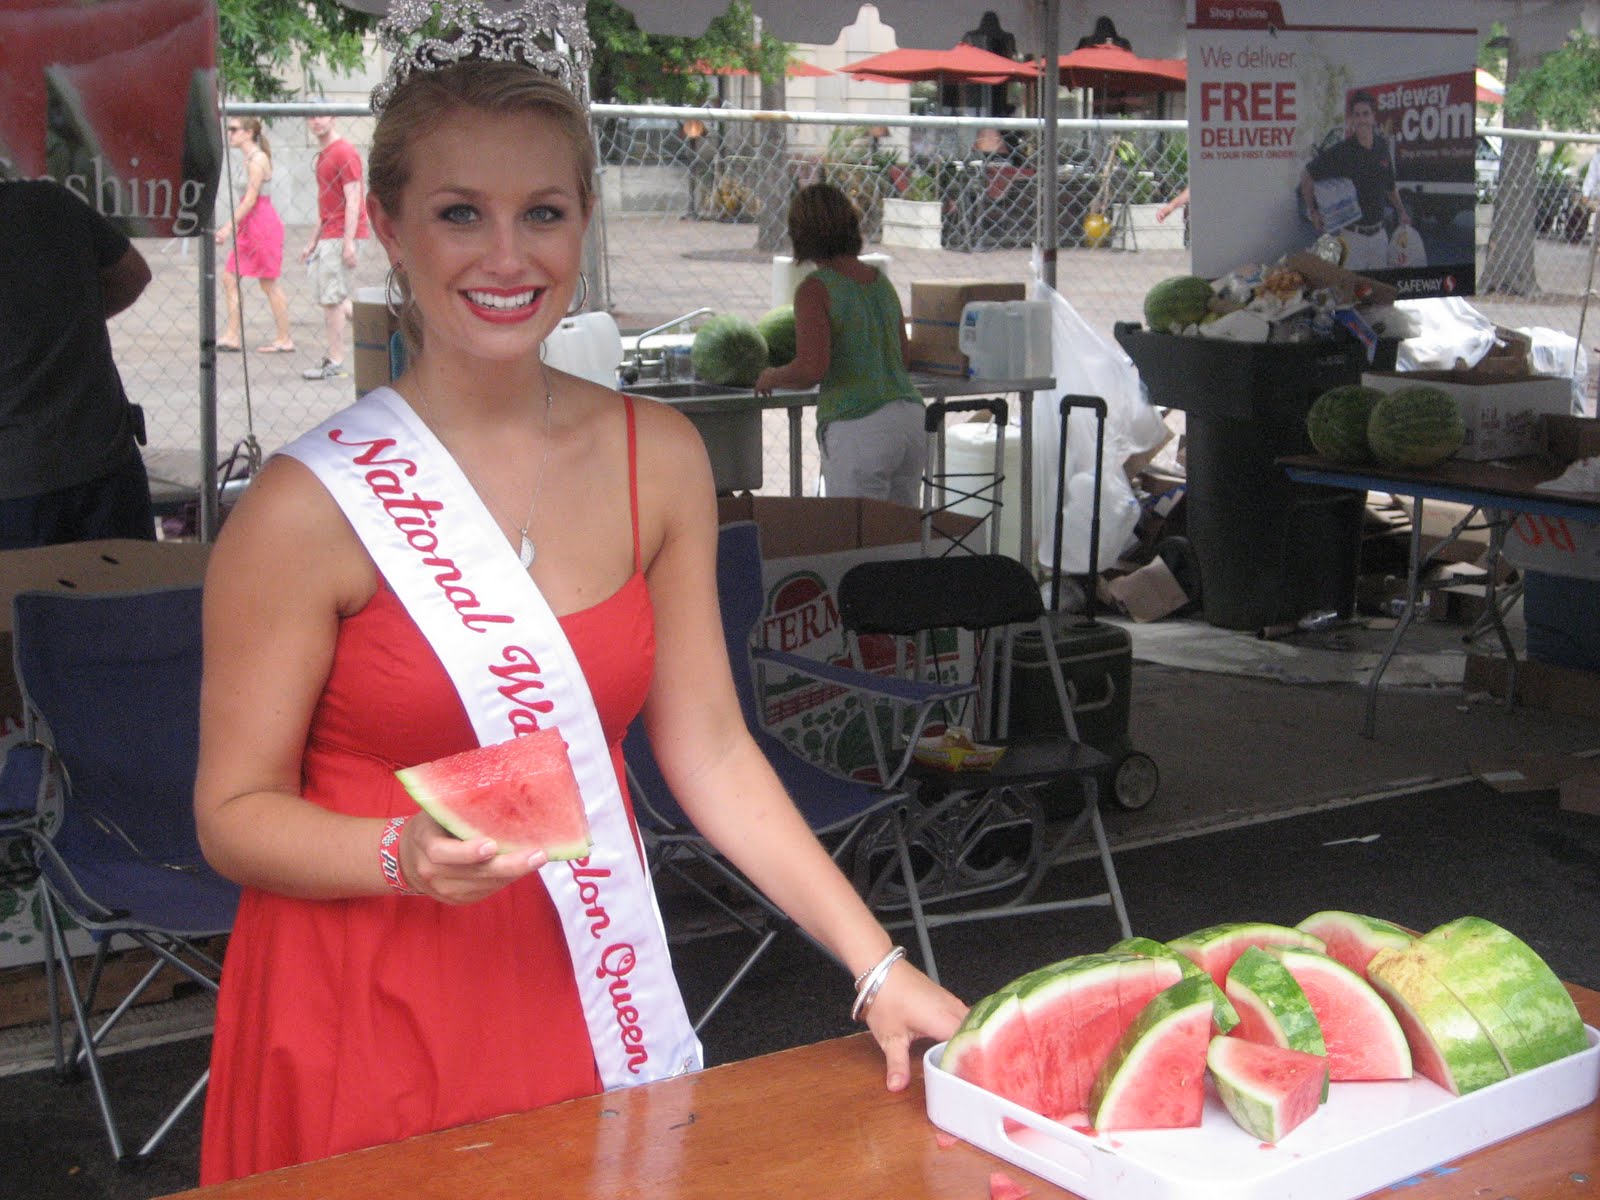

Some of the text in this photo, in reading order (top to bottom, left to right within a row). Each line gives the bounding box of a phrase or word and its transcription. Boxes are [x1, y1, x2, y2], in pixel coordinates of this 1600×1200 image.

[1209, 8, 1269, 20] Shop Online
[1200, 46, 1232, 68] We
[1201, 82, 1297, 121] FREE
[1378, 84, 1450, 110] safeway
[1396, 102, 1472, 141] .com
[1201, 127, 1297, 147] DELIVERY
[1201, 150, 1214, 159] ON
[1216, 150, 1240, 159] YOUR
[1242, 150, 1263, 159] FIRST
[1397, 278, 1442, 293] SAFEWAY
[328, 429, 515, 633] National
[596, 943, 649, 1074] Queen
